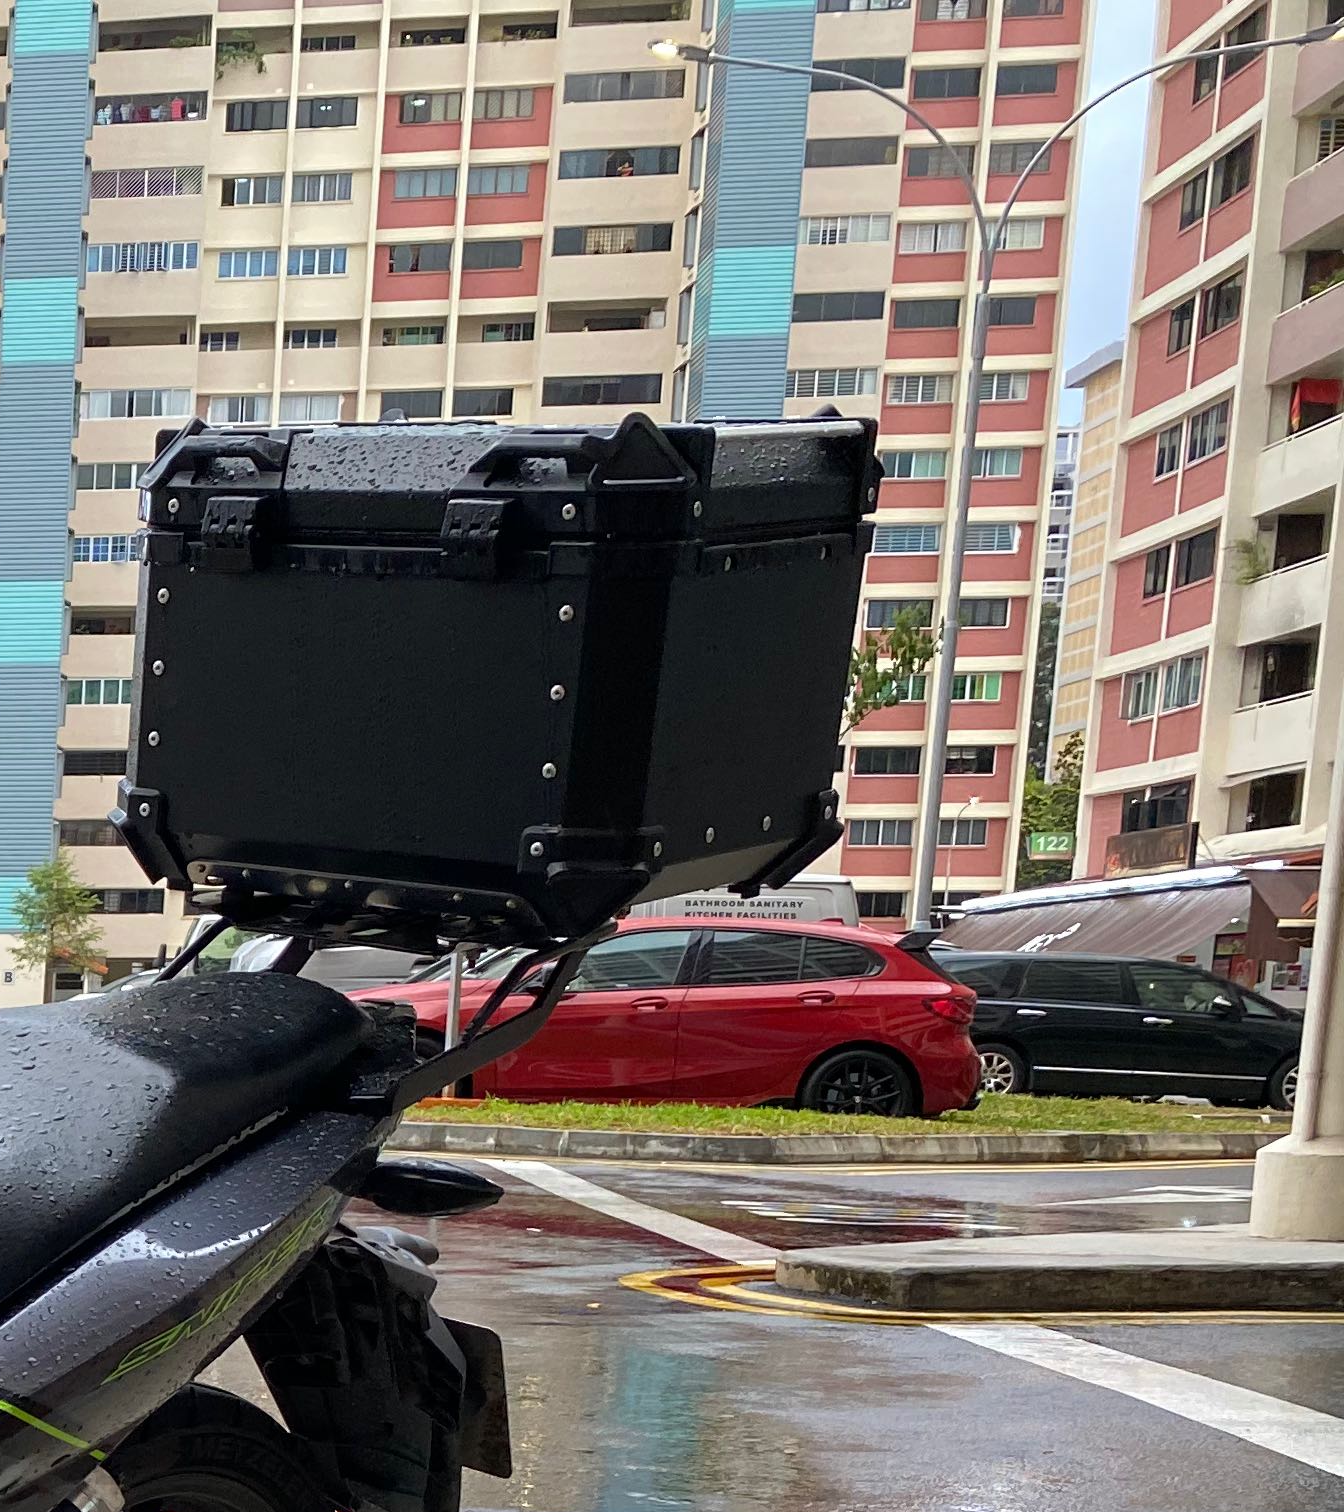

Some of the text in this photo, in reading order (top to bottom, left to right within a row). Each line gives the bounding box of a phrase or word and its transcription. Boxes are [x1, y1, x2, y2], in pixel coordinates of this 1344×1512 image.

[1036, 836, 1069, 852] 122
[685, 900, 804, 909] BATHROOM SANITARY
[737, 912, 797, 920] FACILITIES
[4, 971, 13, 983] B
